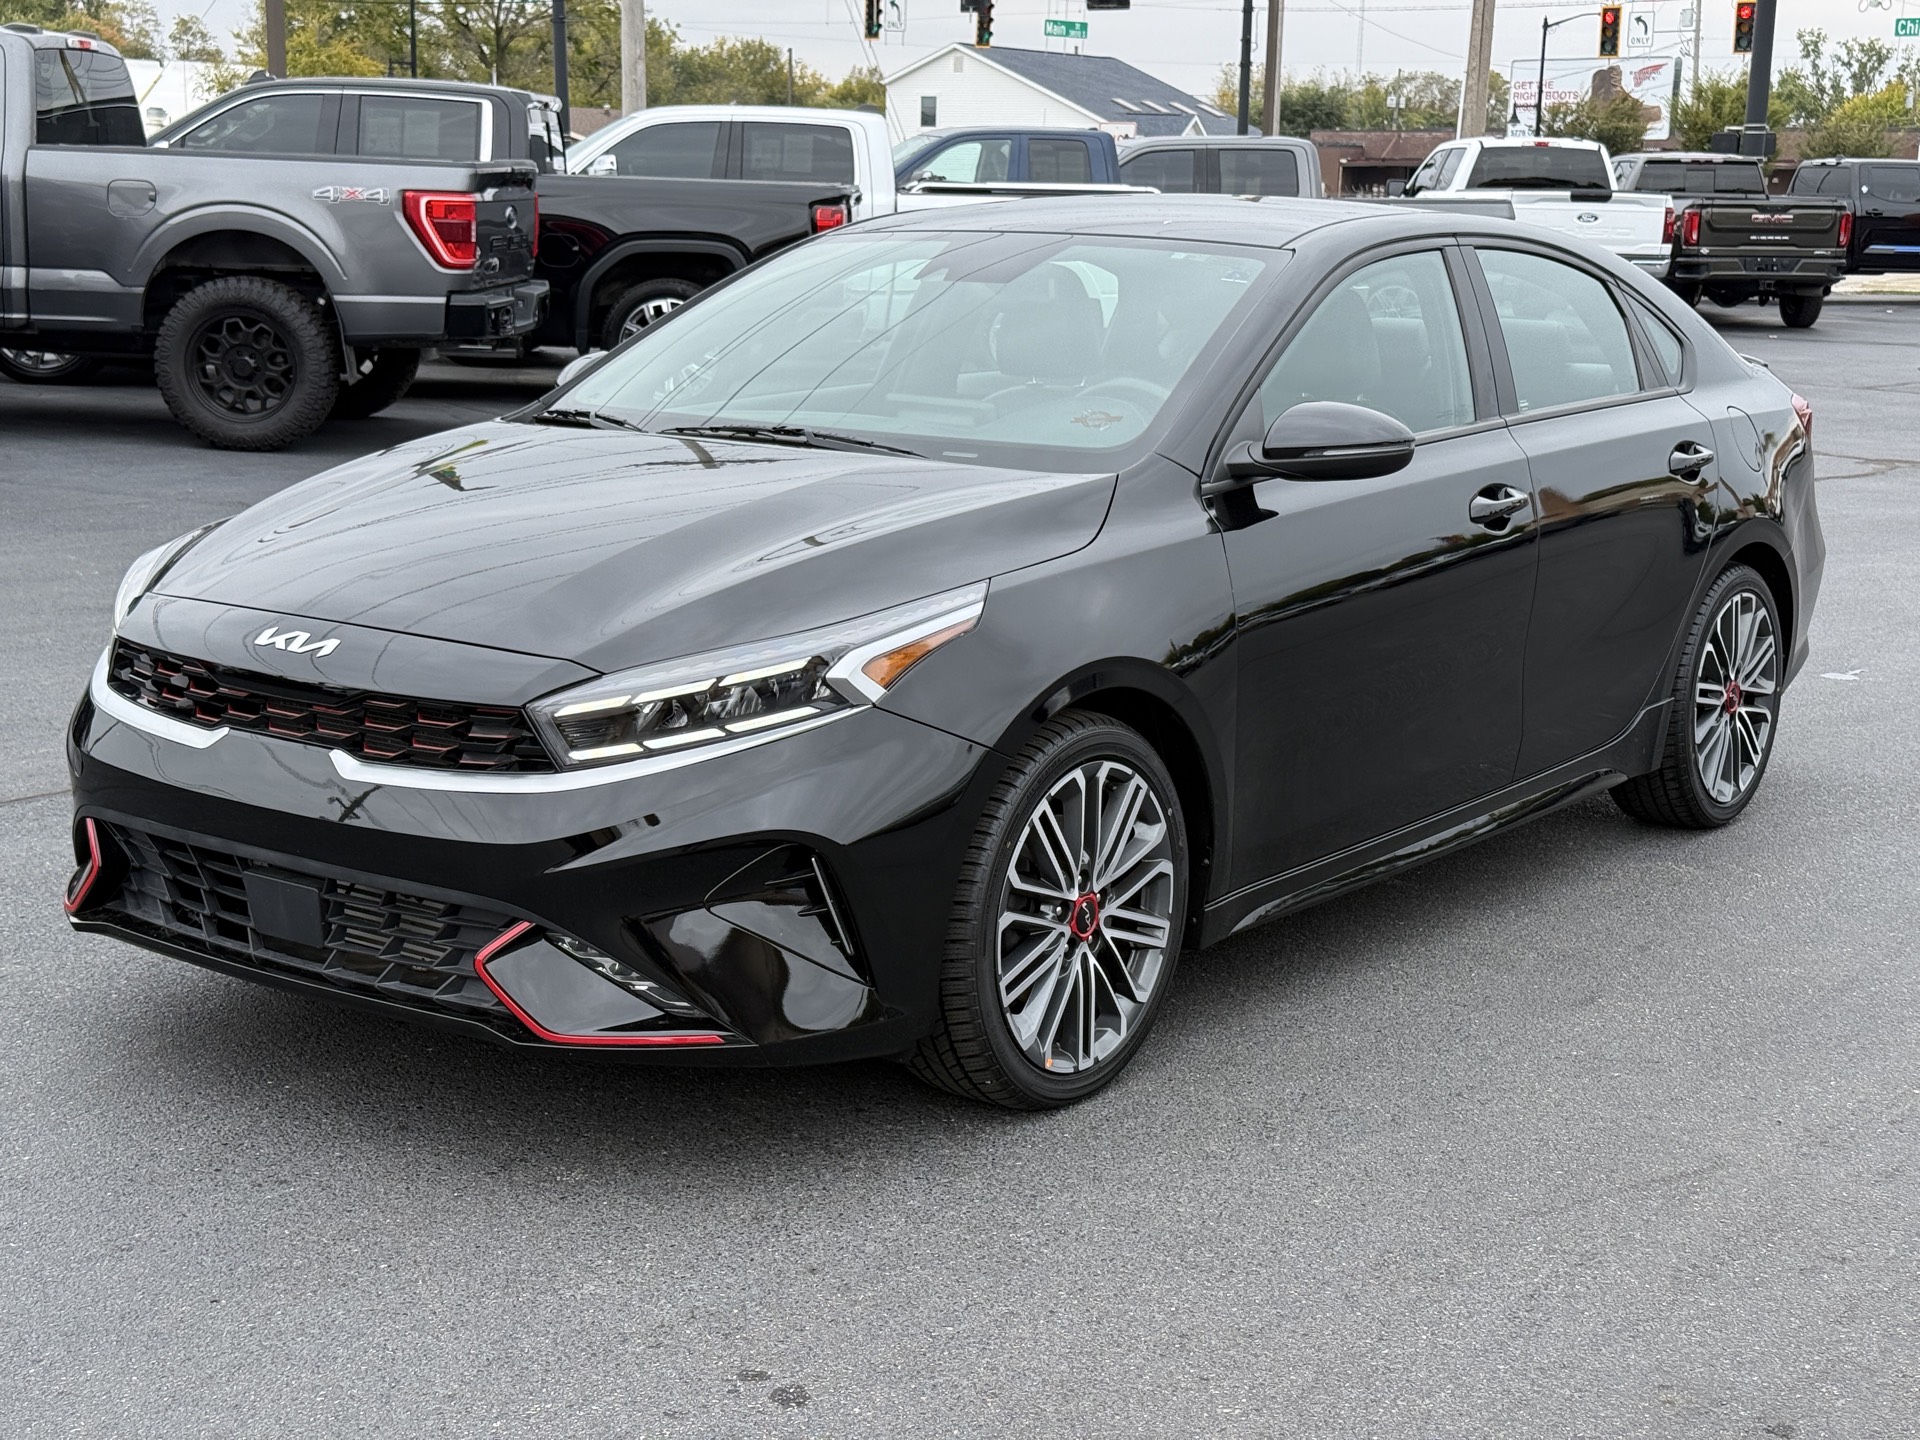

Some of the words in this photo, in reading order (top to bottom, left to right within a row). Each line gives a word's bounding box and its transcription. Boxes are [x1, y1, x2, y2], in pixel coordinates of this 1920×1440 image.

[1046, 21, 1066, 36] Main
[1898, 19, 1920, 35] Chi
[1630, 37, 1650, 45] ONLY
[1513, 81, 1534, 90] GET
[1536, 81, 1554, 90] HE
[1513, 91, 1541, 101] RIGH
[1545, 91, 1579, 101] BOOTS
[1751, 213, 1794, 224] GMC
